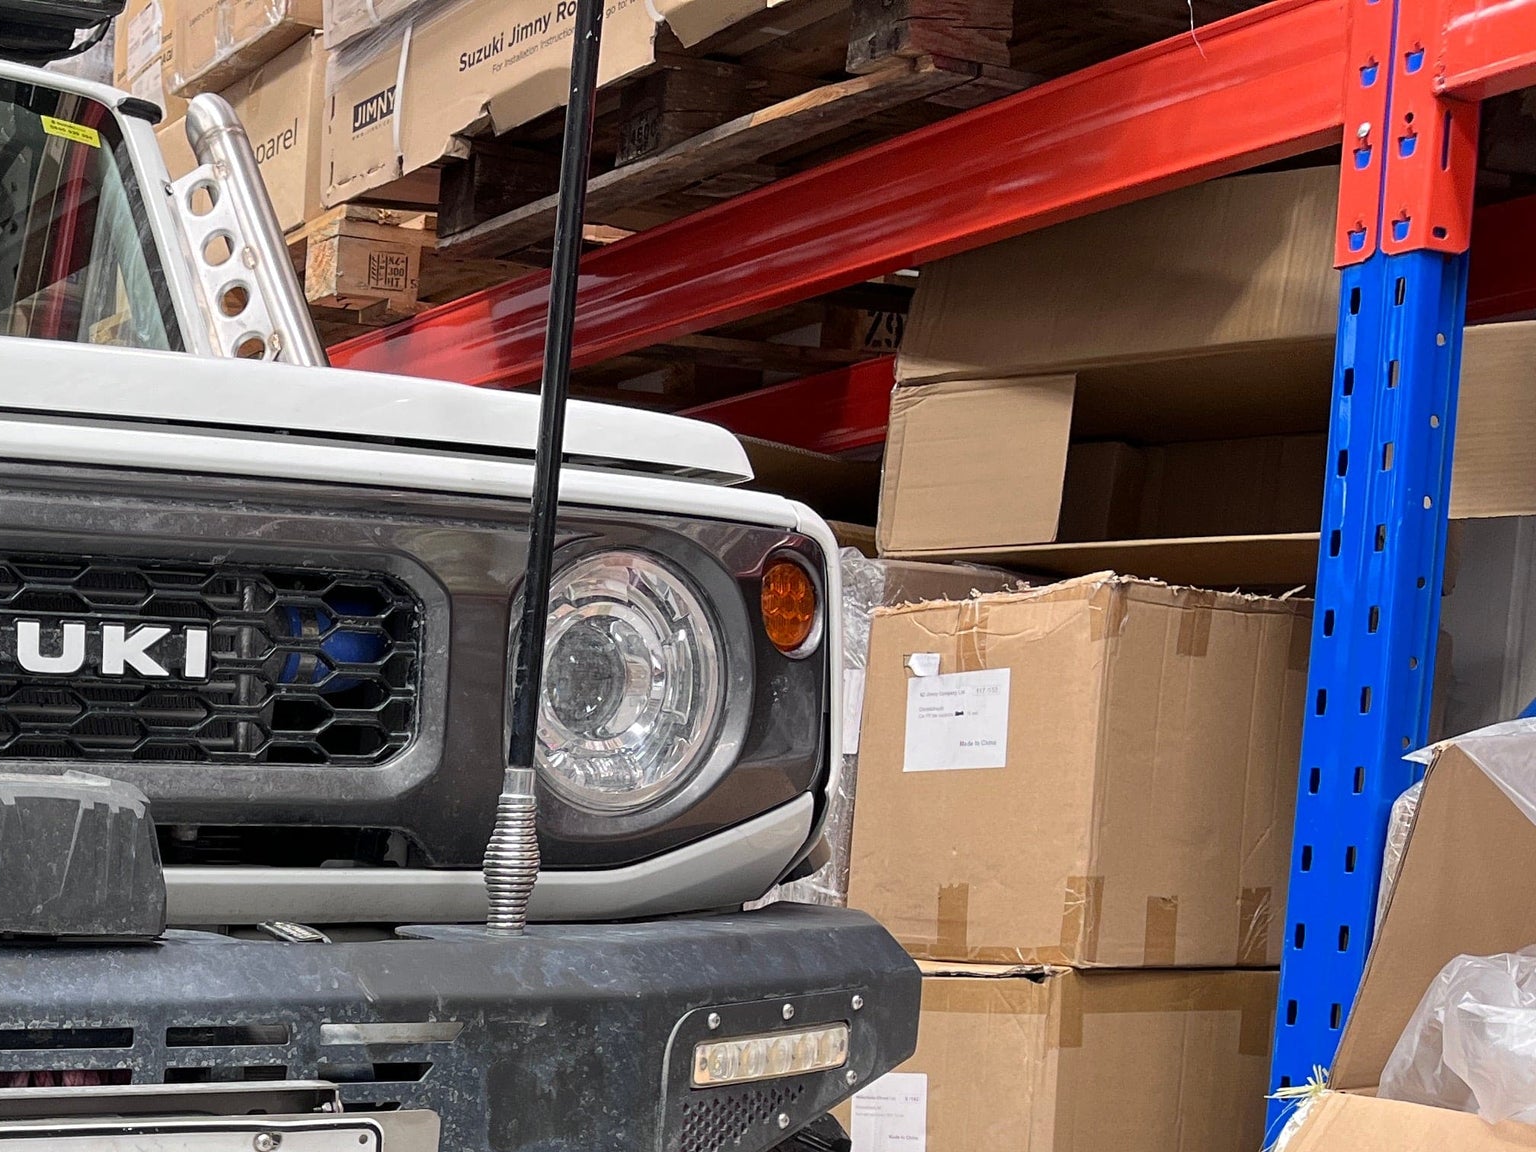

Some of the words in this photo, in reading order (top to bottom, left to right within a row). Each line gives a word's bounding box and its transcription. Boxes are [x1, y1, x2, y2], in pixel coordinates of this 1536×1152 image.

[459, 32, 504, 72] Suzuki
[508, 11, 552, 48] Jimny
[556, 0, 577, 23] Ro
[354, 88, 395, 128] JIMNY
[253, 116, 299, 165] parel
